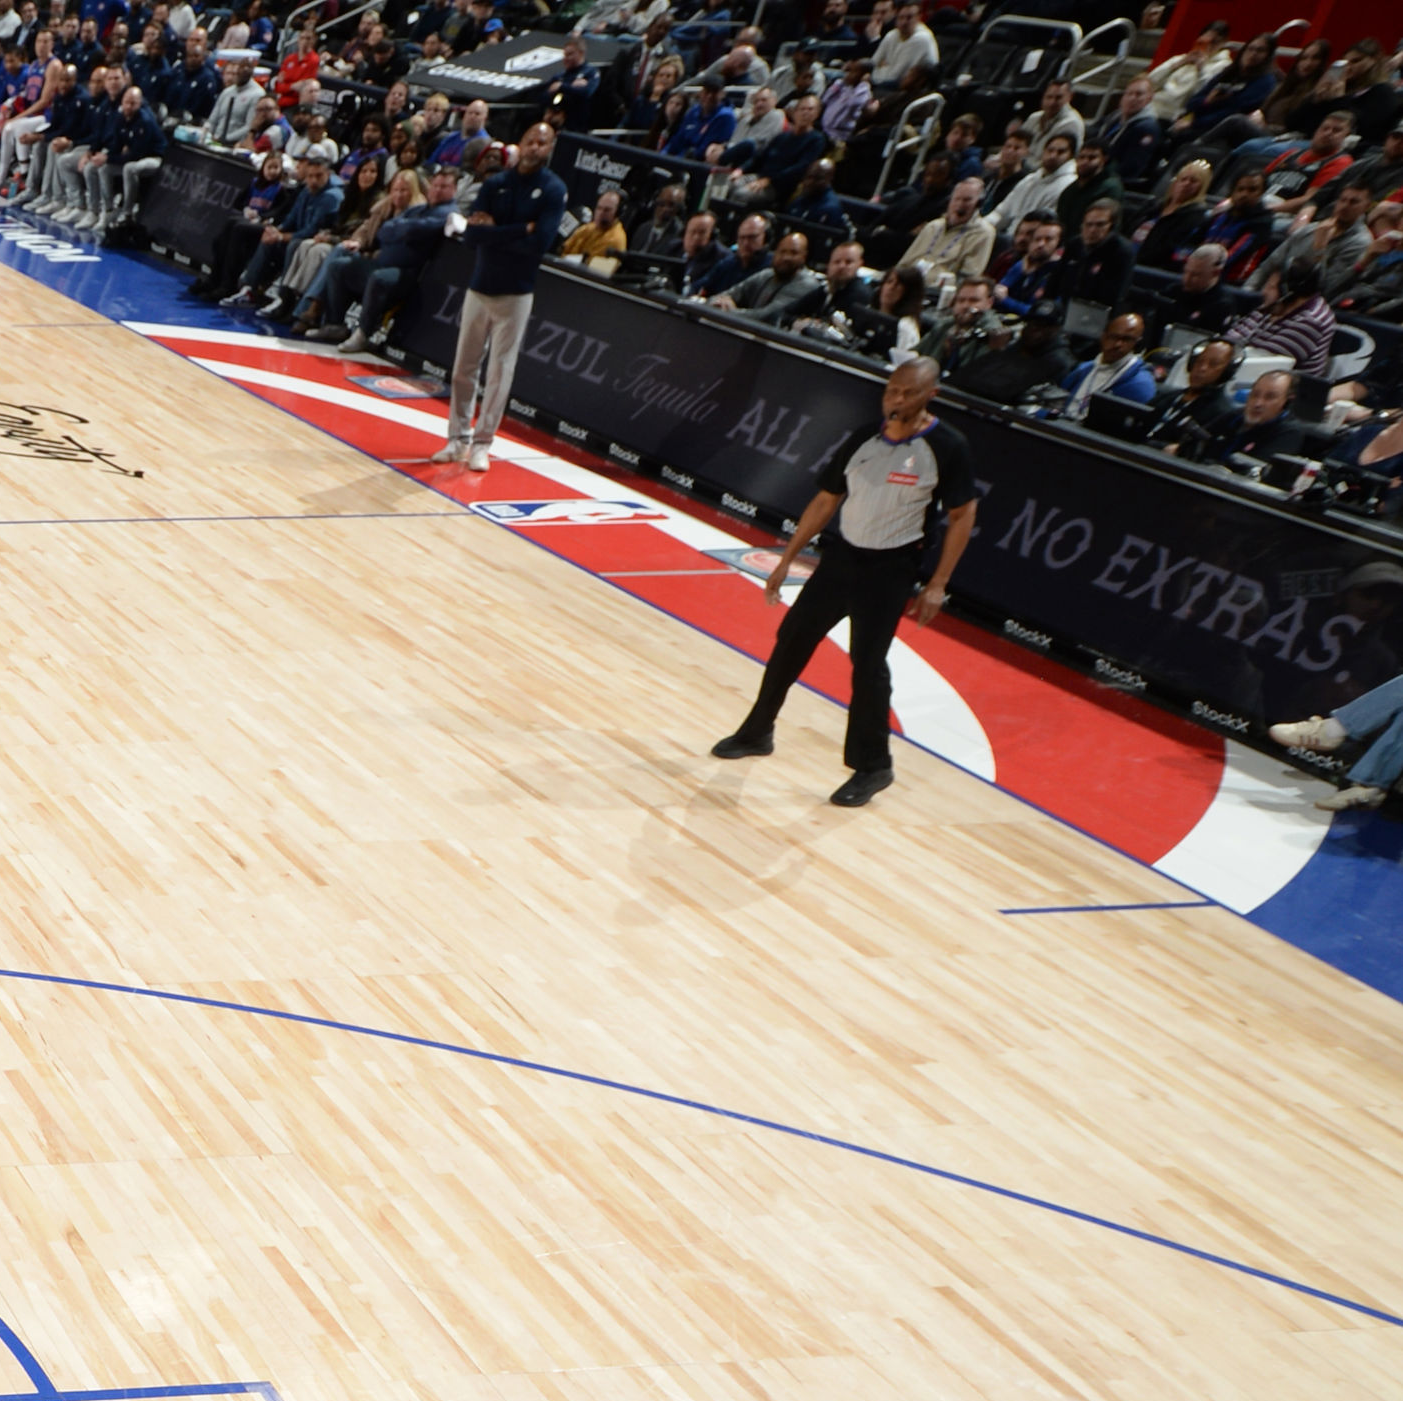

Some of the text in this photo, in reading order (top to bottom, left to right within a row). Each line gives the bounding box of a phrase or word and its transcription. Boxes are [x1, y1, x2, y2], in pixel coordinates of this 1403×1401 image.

[160, 164, 242, 209] LUNAZU
[433, 285, 610, 384] LZUL
[613, 354, 724, 421] Tequila
[726, 399, 812, 464] ALL
[996, 499, 1093, 570] NO
[1094, 534, 1365, 684] EXTRAS.
[721, 492, 758, 518] StockX
[1004, 618, 1052, 650] StockX
[1095, 657, 1147, 691] StockX
[1192, 700, 1249, 734] StockX
